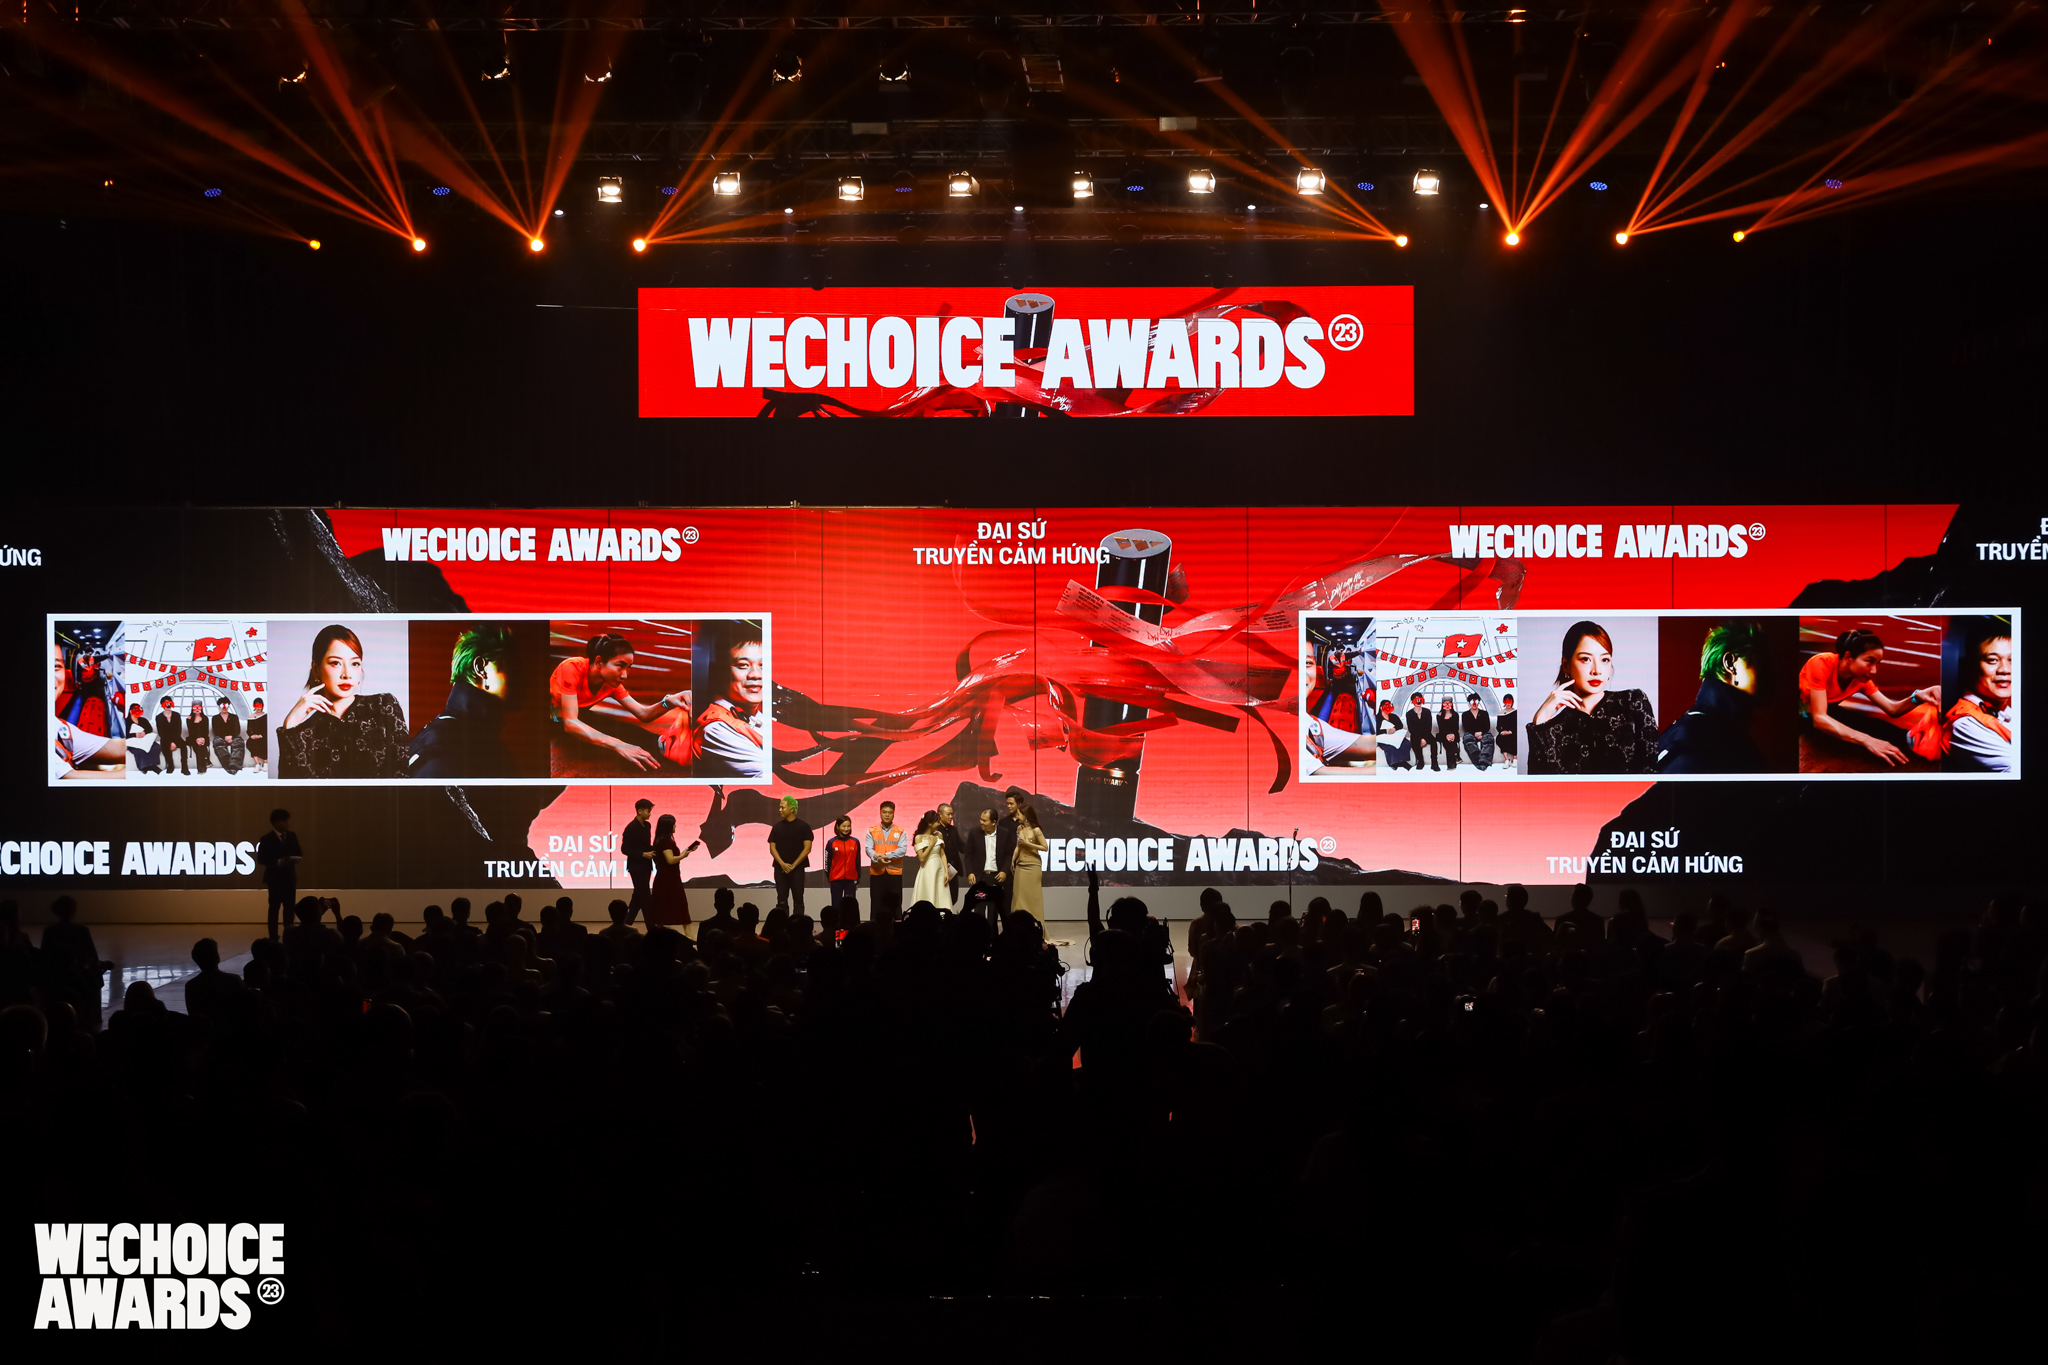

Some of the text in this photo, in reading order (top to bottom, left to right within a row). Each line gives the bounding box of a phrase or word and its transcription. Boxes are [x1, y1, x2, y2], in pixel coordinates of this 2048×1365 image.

[688, 316, 1016, 389] WECHOICE
[1041, 317, 1325, 389] AWARDS
[977, 518, 1048, 543] ĐẠI SỨ
[1449, 524, 1603, 558] WECHOICE
[1614, 523, 1749, 558] AWARDS
[382, 528, 537, 562] WECHOICE
[548, 527, 682, 562] AWARDS
[913, 540, 1111, 565] TRUYỀN CẢM HỨNG
[549, 831, 618, 856] ĐẠI SỨ
[1610, 827, 1680, 852] ĐẠI SỨ
[0, 841, 256, 875] CHOICE AWARDS
[484, 853, 564, 878] TRUYỀN
[570, 855, 617, 878] CẢM
[1038, 838, 1174, 871] ECHOICE
[1185, 837, 1319, 871] AWARDS
[1546, 849, 1744, 873] TRUYỀN CẢM HỨNG
